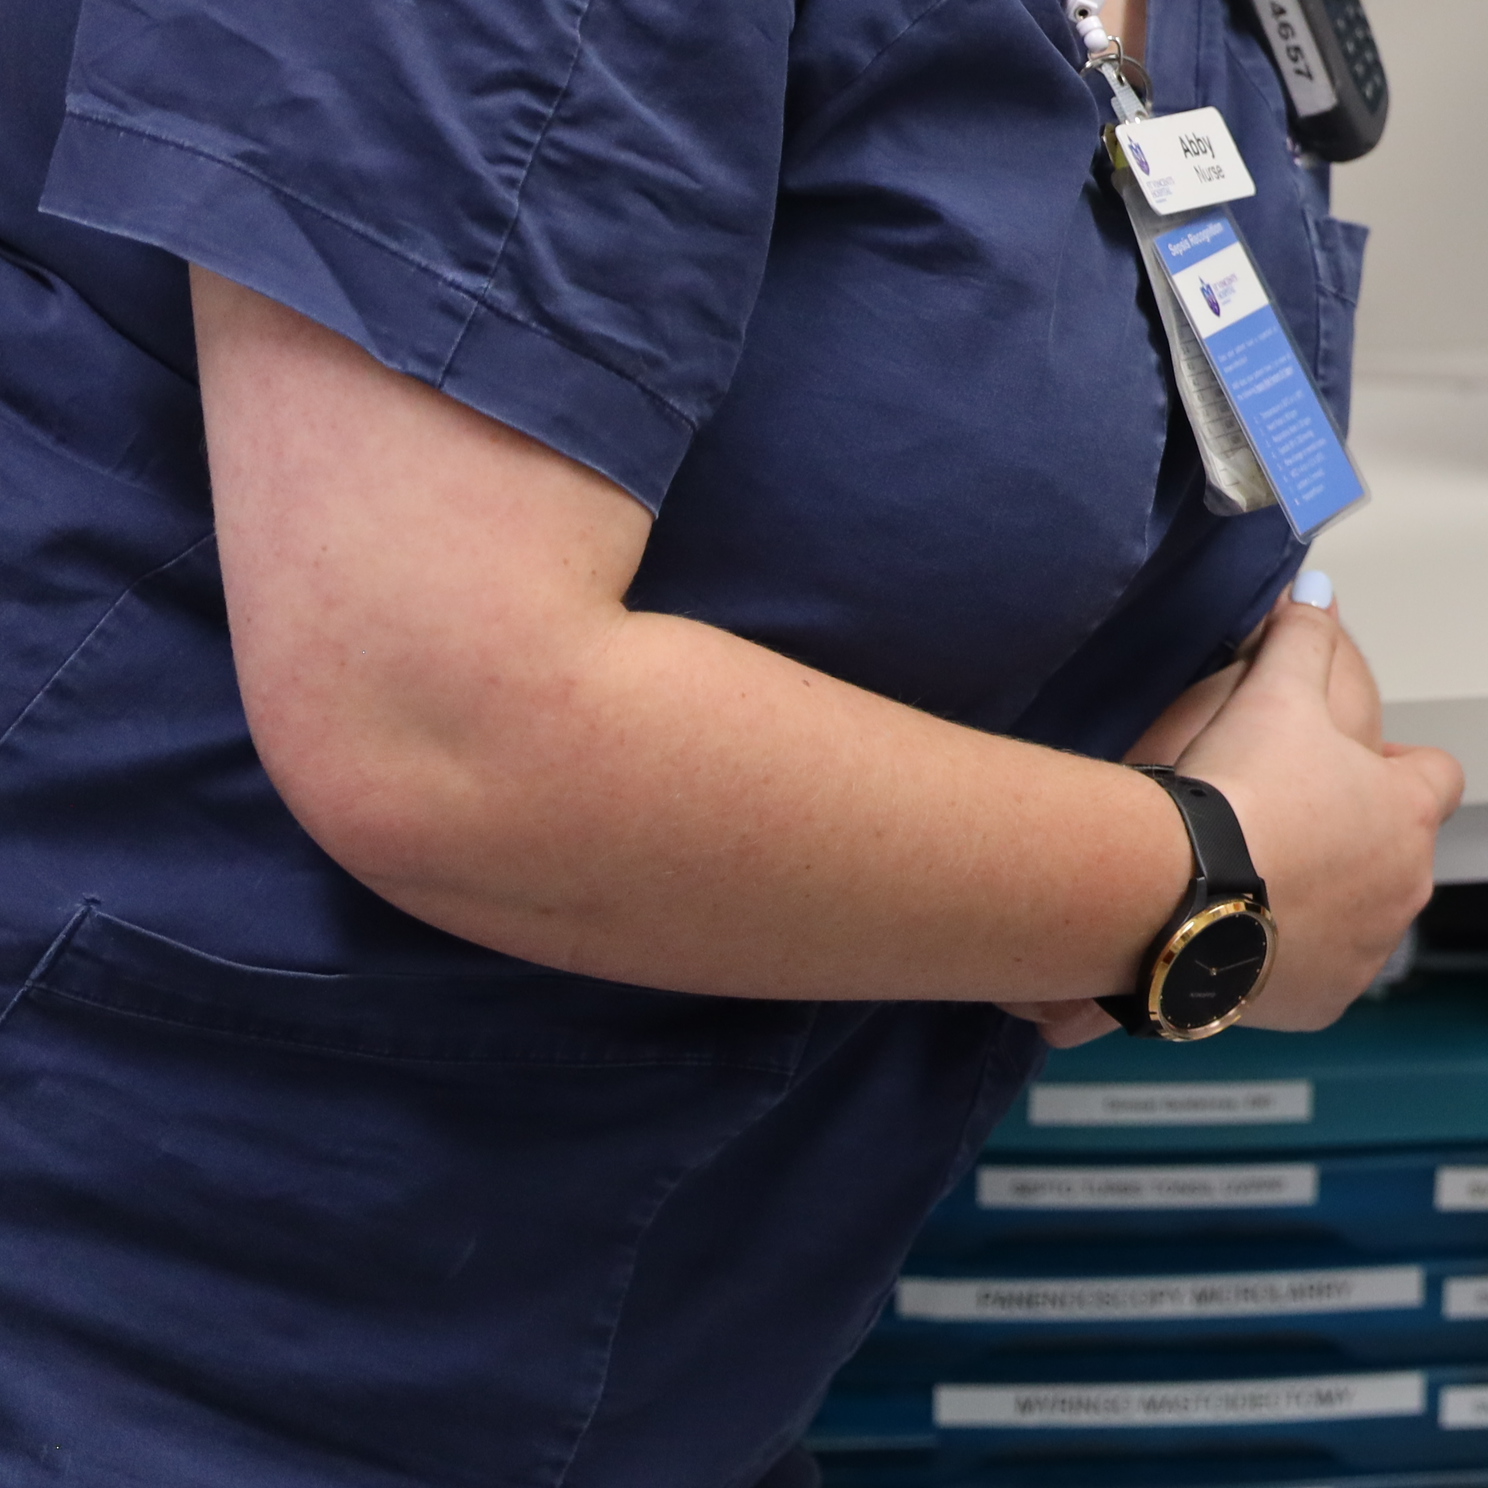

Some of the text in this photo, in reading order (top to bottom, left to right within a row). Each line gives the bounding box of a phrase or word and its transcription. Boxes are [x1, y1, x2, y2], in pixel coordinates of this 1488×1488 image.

[1178, 132, 1215, 160] Abby
[1193, 163, 1226, 184] Nurse
[1167, 221, 1225, 257] Sepsis Recognition
